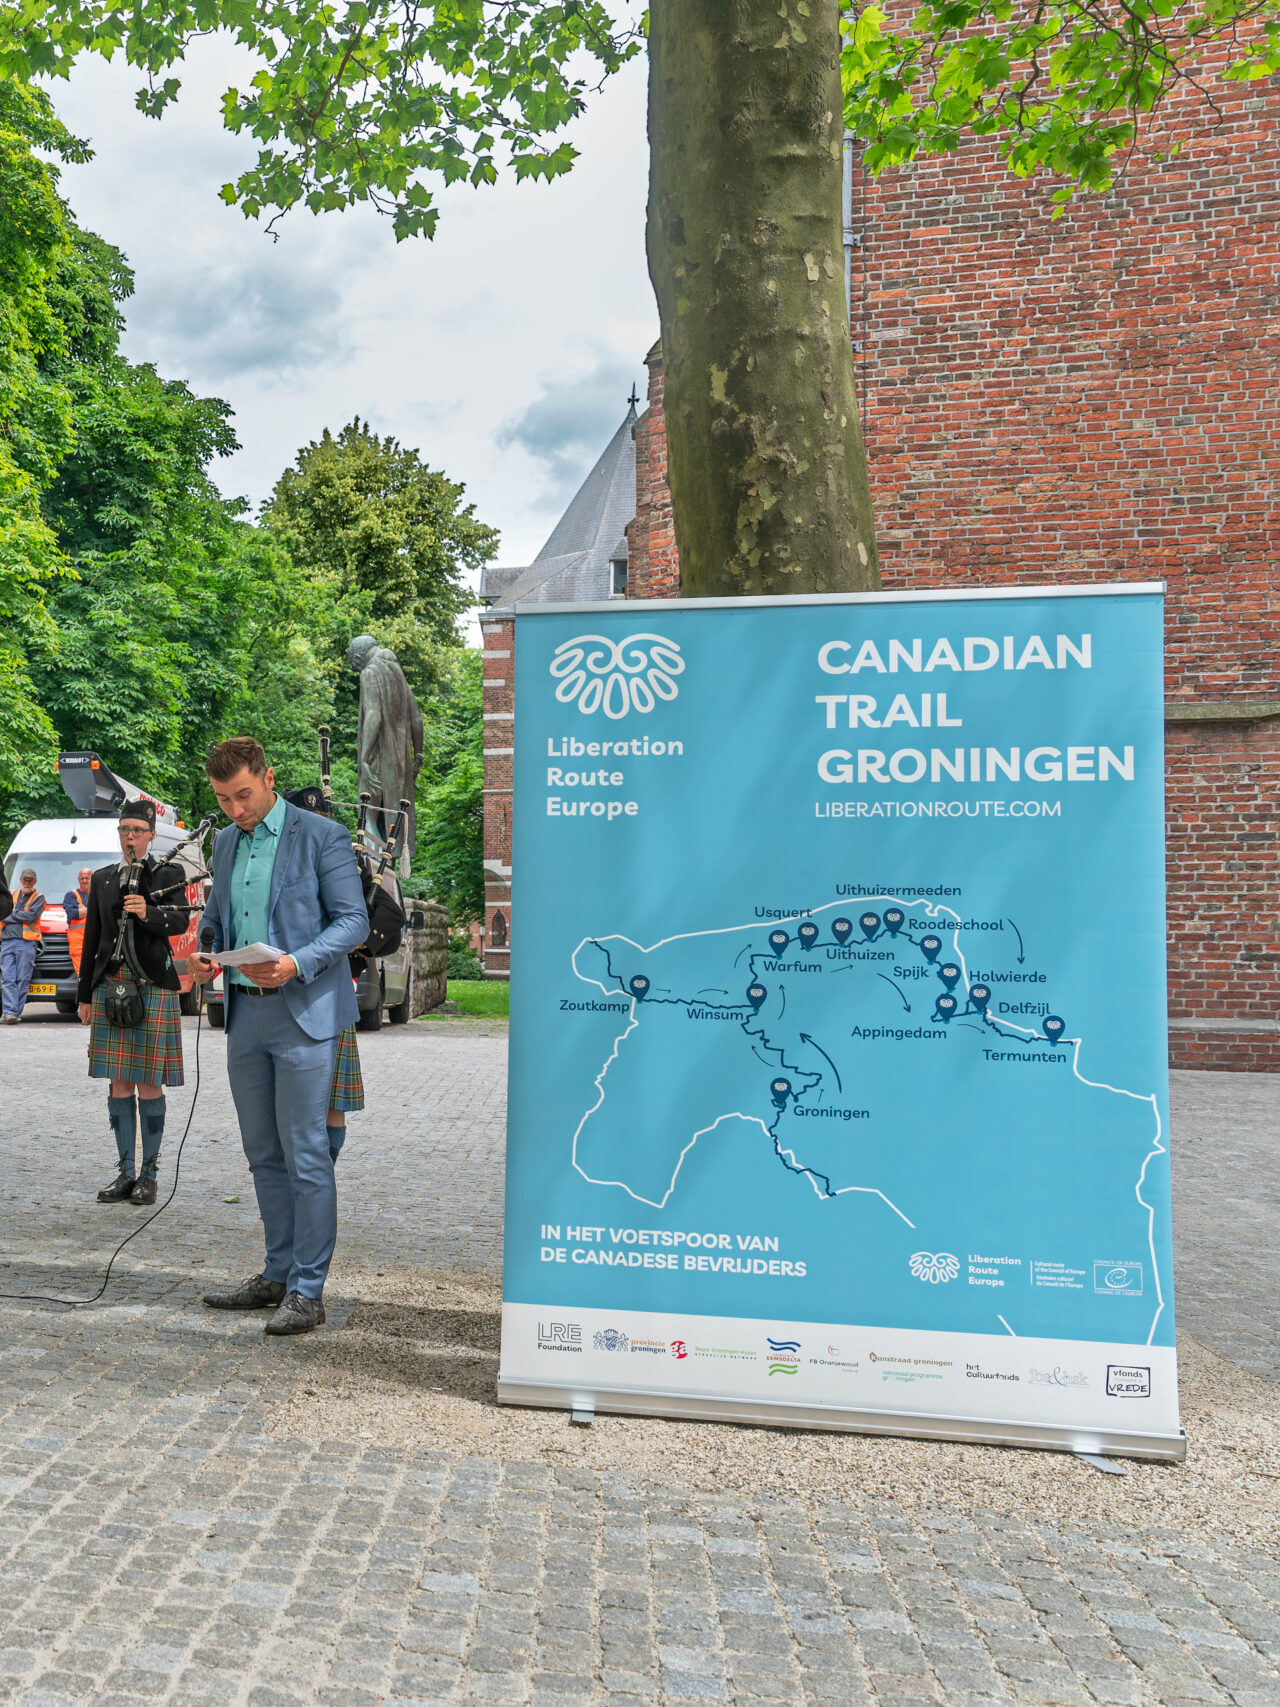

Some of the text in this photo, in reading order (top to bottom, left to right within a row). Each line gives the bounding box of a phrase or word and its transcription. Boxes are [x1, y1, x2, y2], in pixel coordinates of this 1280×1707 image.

[817, 633, 1092, 675] CANADIAN
[815, 692, 963, 729] TRAIL
[547, 735, 684, 757] Liberation
[817, 745, 1135, 784] GRONINGEN
[547, 767, 624, 787] Route
[546, 796, 639, 821] Europe
[815, 800, 1062, 818] LIBERATIONROUTE.COM
[835, 883, 962, 896] Uithuizermeeden
[754, 906, 813, 920] Usquert
[908, 918, 1005, 931] Roodeschool
[826, 948, 896, 961] Uithuizen
[763, 960, 822, 973] Warfum
[893, 966, 930, 980] Spijk
[969, 971, 1048, 984] Holwierde
[559, 999, 630, 1015] Zoutkamp
[998, 1002, 1052, 1016] Delfzijl
[686, 1008, 744, 1021] Winsum
[850, 1025, 947, 1041] Appingedam
[981, 1048, 1067, 1063] Termunten
[793, 1104, 870, 1121] Groningen
[541, 1224, 779, 1252] IN HET VOETSPOOR VAN
[540, 1246, 807, 1277] DE CANADESE BEVRIJDERS
[968, 1254, 1022, 1266] Liberation
[968, 1265, 999, 1275] Route
[968, 1276, 1006, 1288] Europe
[538, 1321, 582, 1344] LRE
[538, 1342, 582, 1353] Foundation
[631, 1339, 666, 1348] provincie
[631, 1346, 666, 1354] groningen
[819, 1359, 859, 1369] Oranjewoud
[913, 1357, 953, 1367] groningen
[966, 1363, 980, 1371] het
[966, 1371, 1020, 1381] Cultuurfonds
[1113, 1370, 1143, 1378] vfonds
[1109, 1383, 1148, 1393] VREDE
